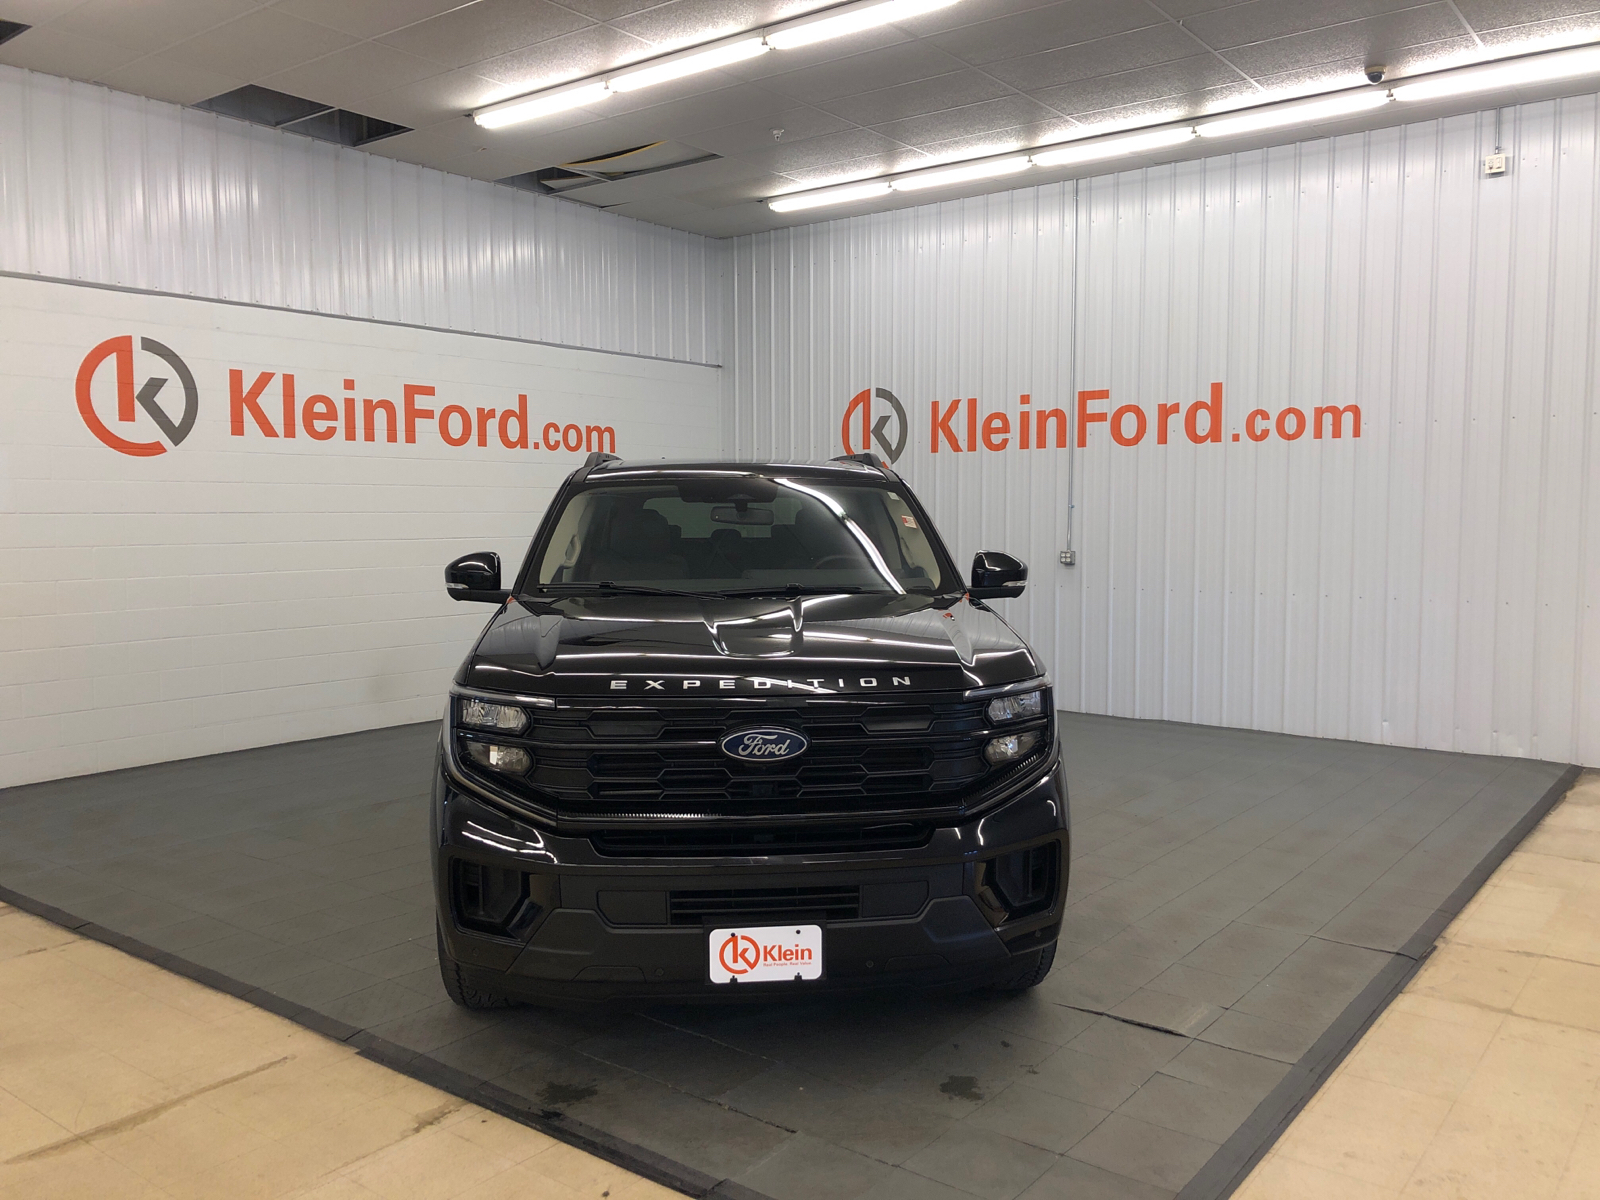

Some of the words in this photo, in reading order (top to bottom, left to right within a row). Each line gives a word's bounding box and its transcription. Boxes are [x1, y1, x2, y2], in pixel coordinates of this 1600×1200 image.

[229, 368, 616, 454] KleinFord.com
[931, 382, 1361, 454] KleinFord.com
[610, 676, 912, 690] EXPEDITION
[738, 733, 791, 757] Ford
[763, 944, 813, 962] Klein
